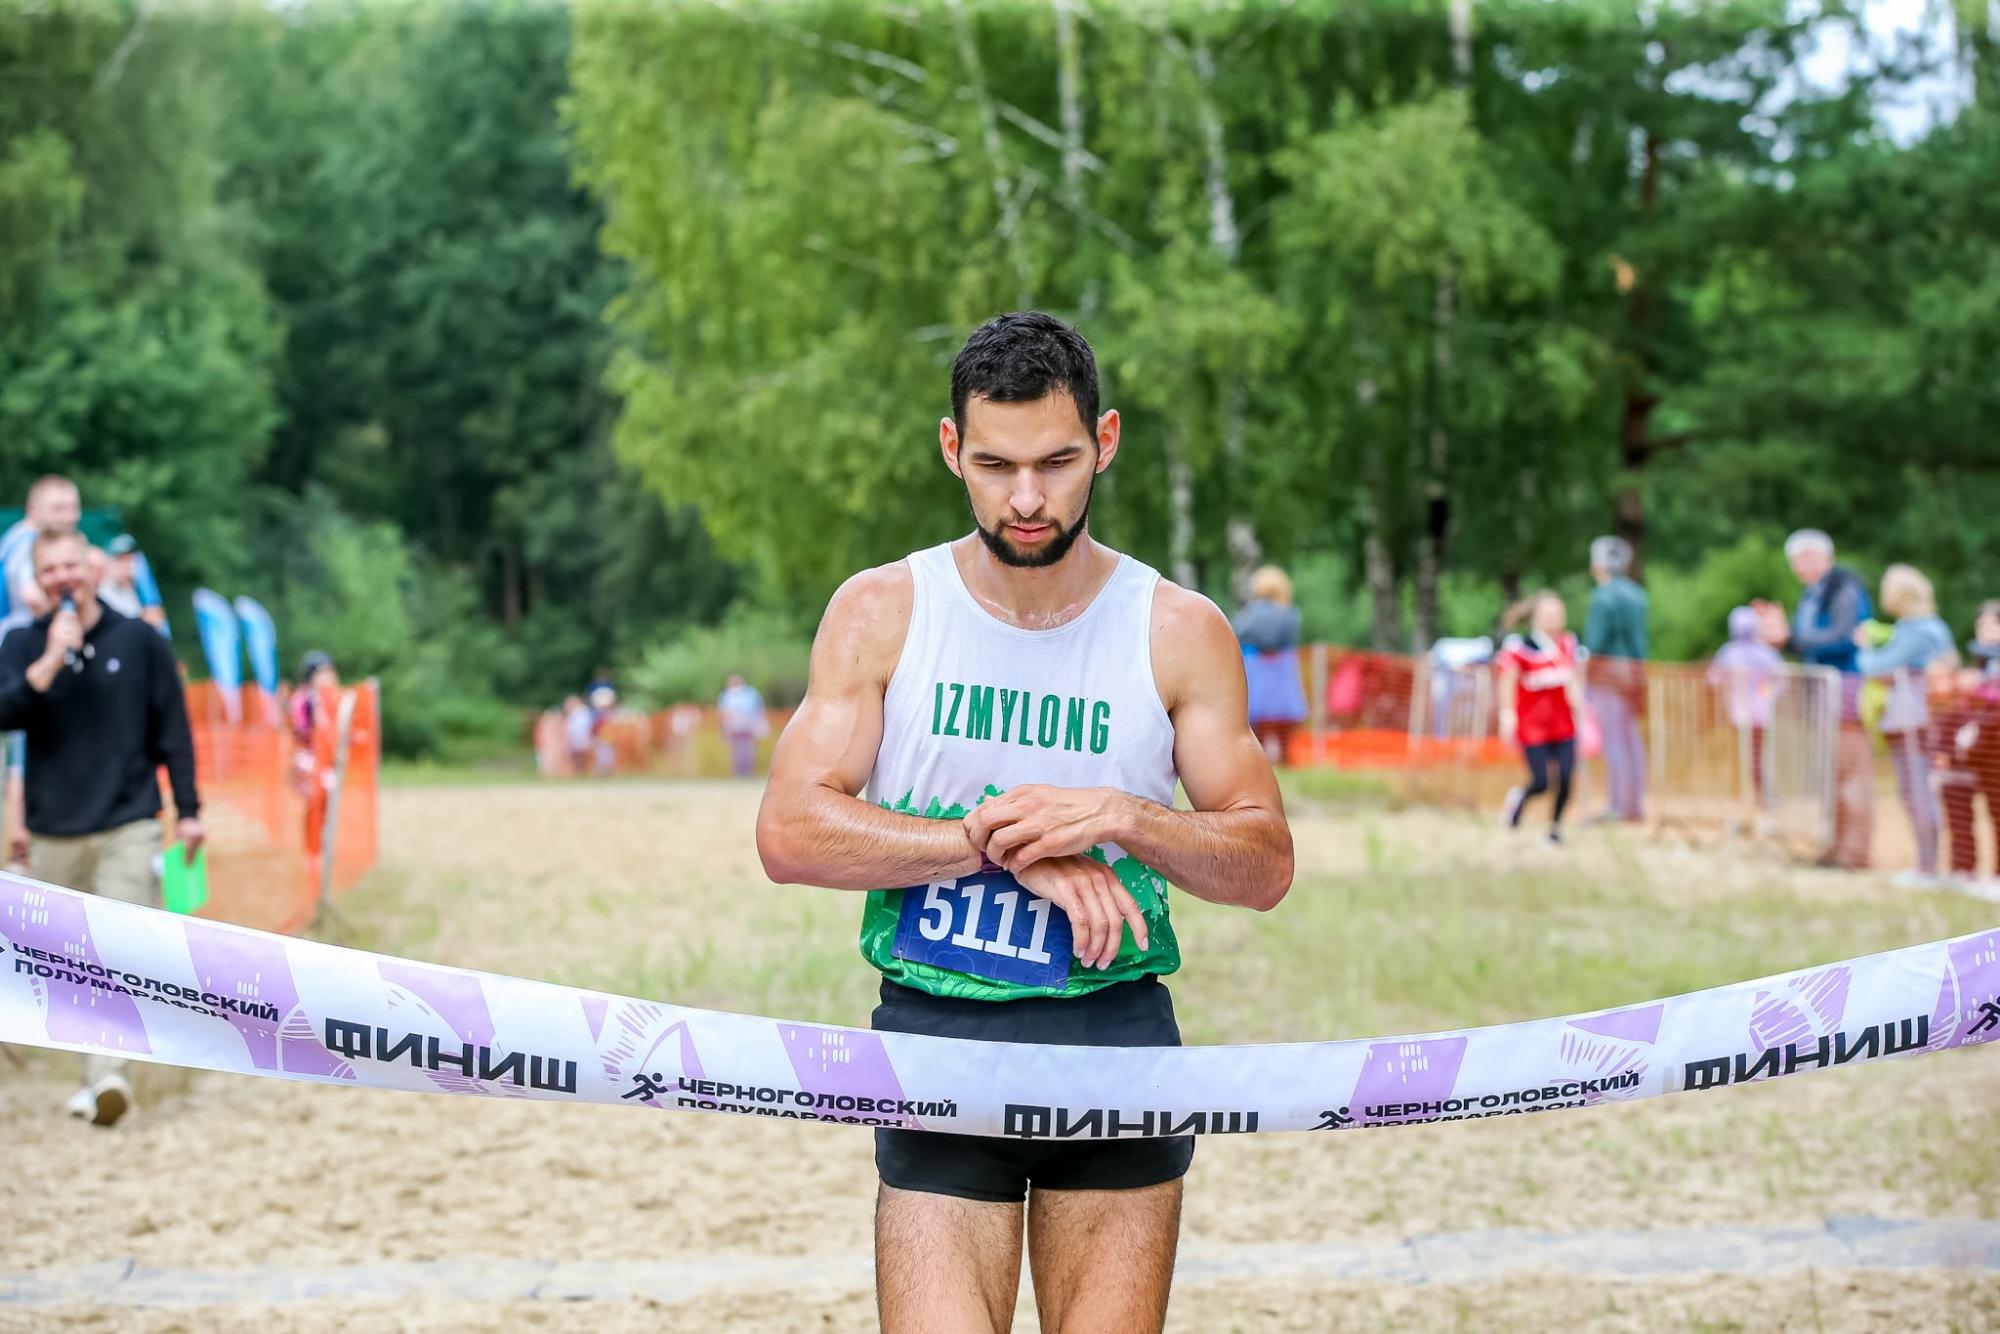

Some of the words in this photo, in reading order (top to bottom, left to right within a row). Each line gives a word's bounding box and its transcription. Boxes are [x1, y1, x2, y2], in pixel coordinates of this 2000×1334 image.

[932, 682, 1111, 754] IZMYLONG
[919, 880, 1052, 965] 5111
[12, 943, 279, 1022] ЧЕРНОГОЛОВСКИЙ
[15, 959, 229, 1020] ПОЛУМАРАФОН
[325, 1018, 577, 1094] ФИНИШ
[1684, 1014, 1929, 1091] ФИНИШ
[678, 1077, 957, 1118] ЧЕРНОГОЛОВСКИЙ
[678, 1097, 903, 1127] ПОЛУМАРАФОН
[1004, 1104, 1258, 1138] ФИНИШ
[1365, 1070, 1639, 1117] ЧЕРНОГОЛОВСКИЙ
